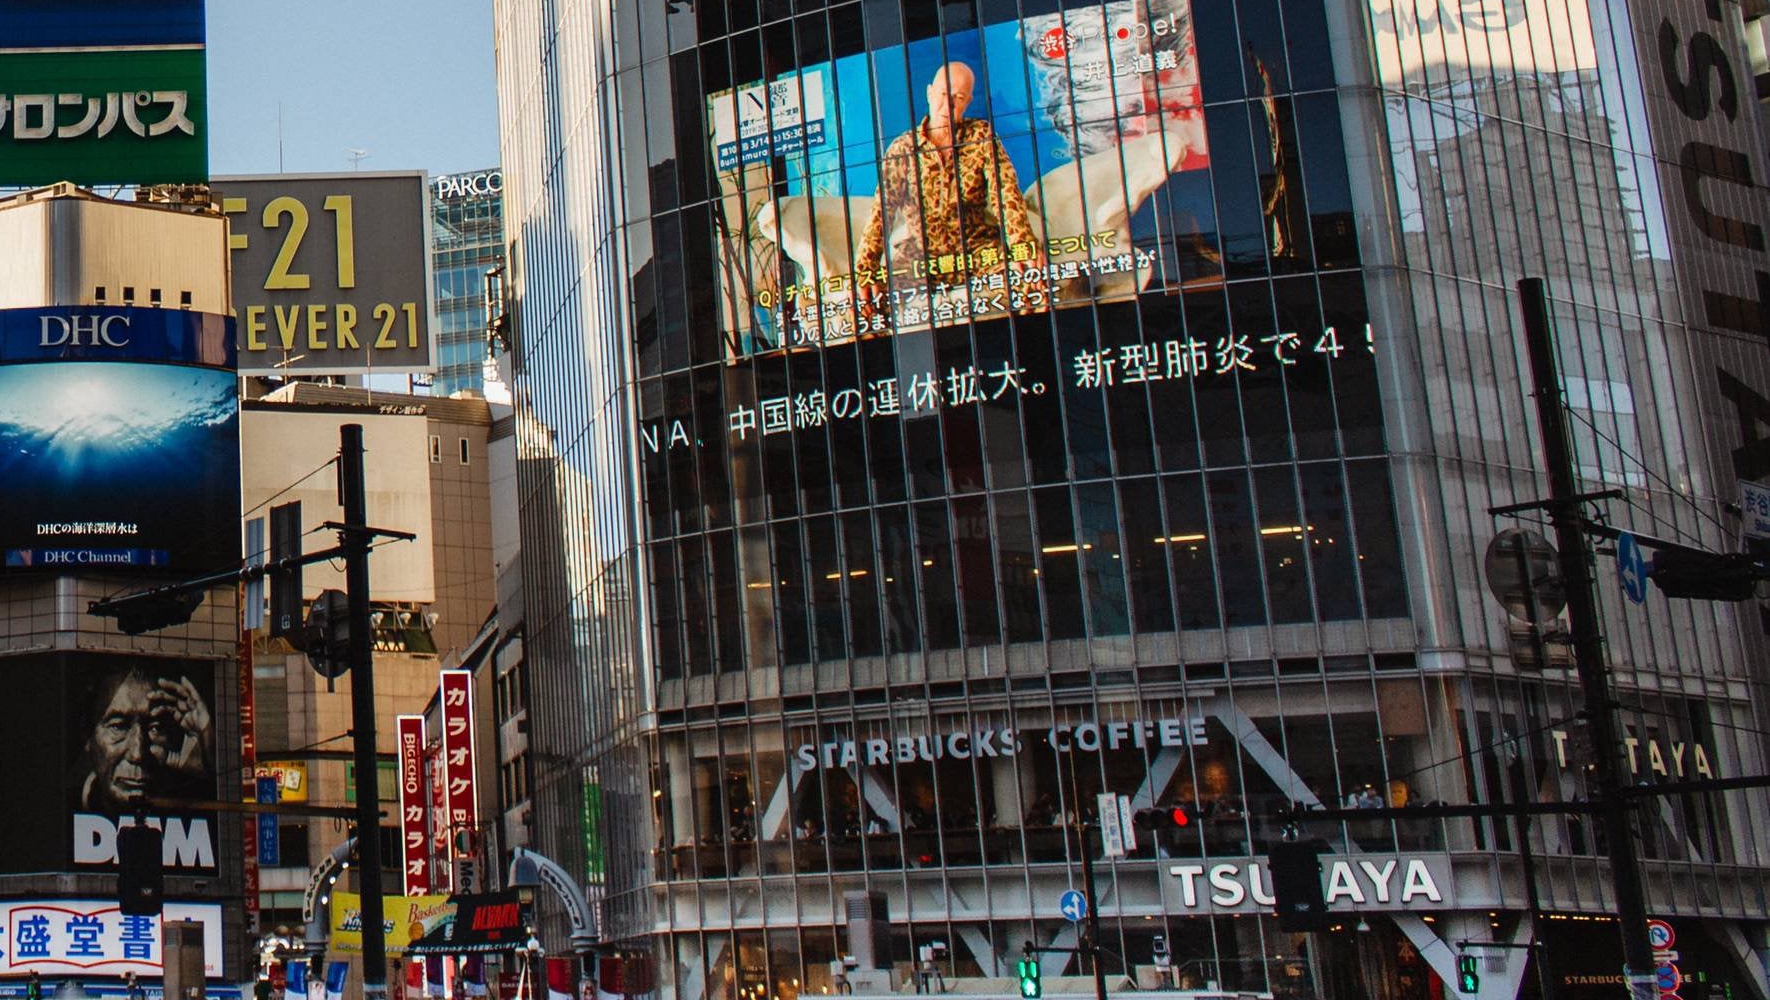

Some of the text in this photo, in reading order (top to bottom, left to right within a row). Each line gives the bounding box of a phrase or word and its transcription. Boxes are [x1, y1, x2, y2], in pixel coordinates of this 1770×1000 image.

[437, 171, 502, 200] PARCO
[38, 314, 131, 348] DHC
[238, 301, 419, 352] EVER 21
[43, 548, 131, 564] DHC Channel
[446, 686, 472, 797] カラオケ
[796, 718, 1210, 773] STARBUCKS COFFEE
[1551, 729, 1714, 780] TTAYA
[73, 813, 216, 868] DM
[404, 804, 428, 898] カラオケ
[1168, 858, 1443, 909] TSUAYA
